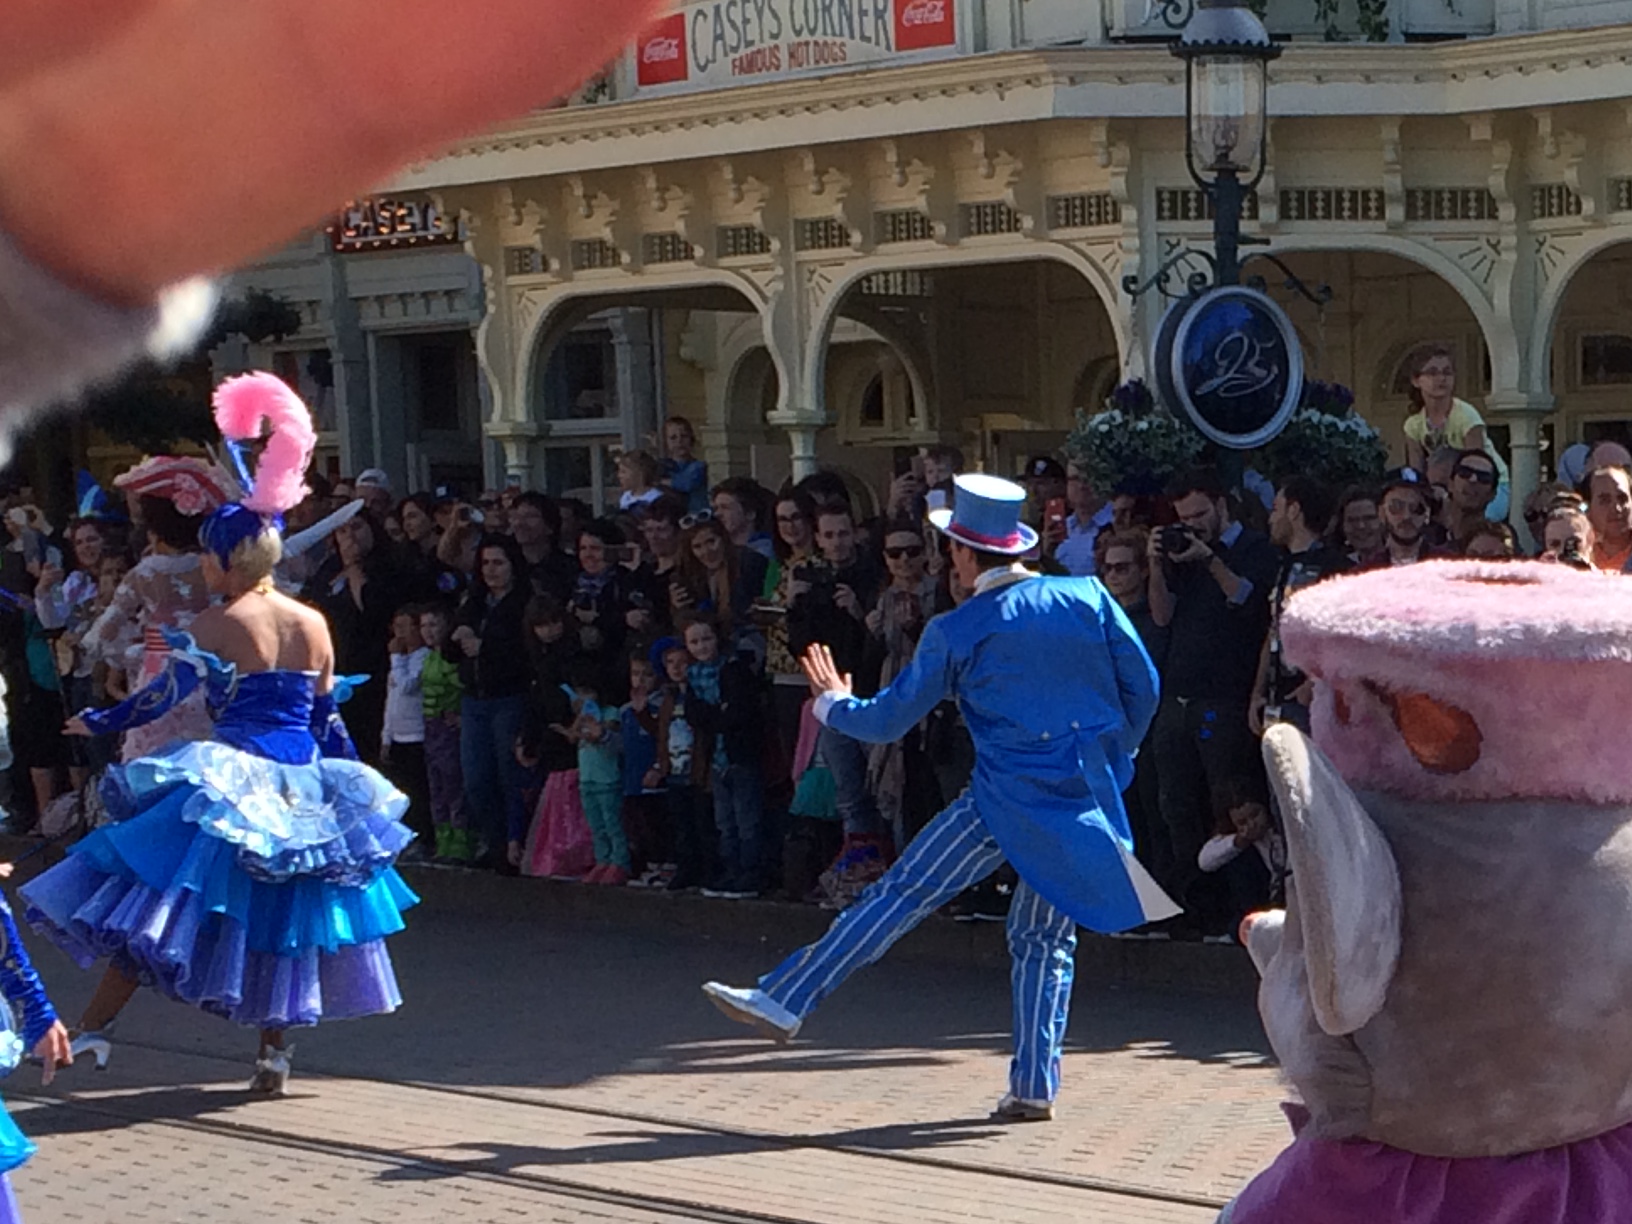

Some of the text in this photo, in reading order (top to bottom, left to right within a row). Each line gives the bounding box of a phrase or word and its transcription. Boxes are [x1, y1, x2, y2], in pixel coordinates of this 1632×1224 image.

[789, 0, 892, 53] CORNER
[731, 38, 847, 76] FAMOUS HOT DOGS
